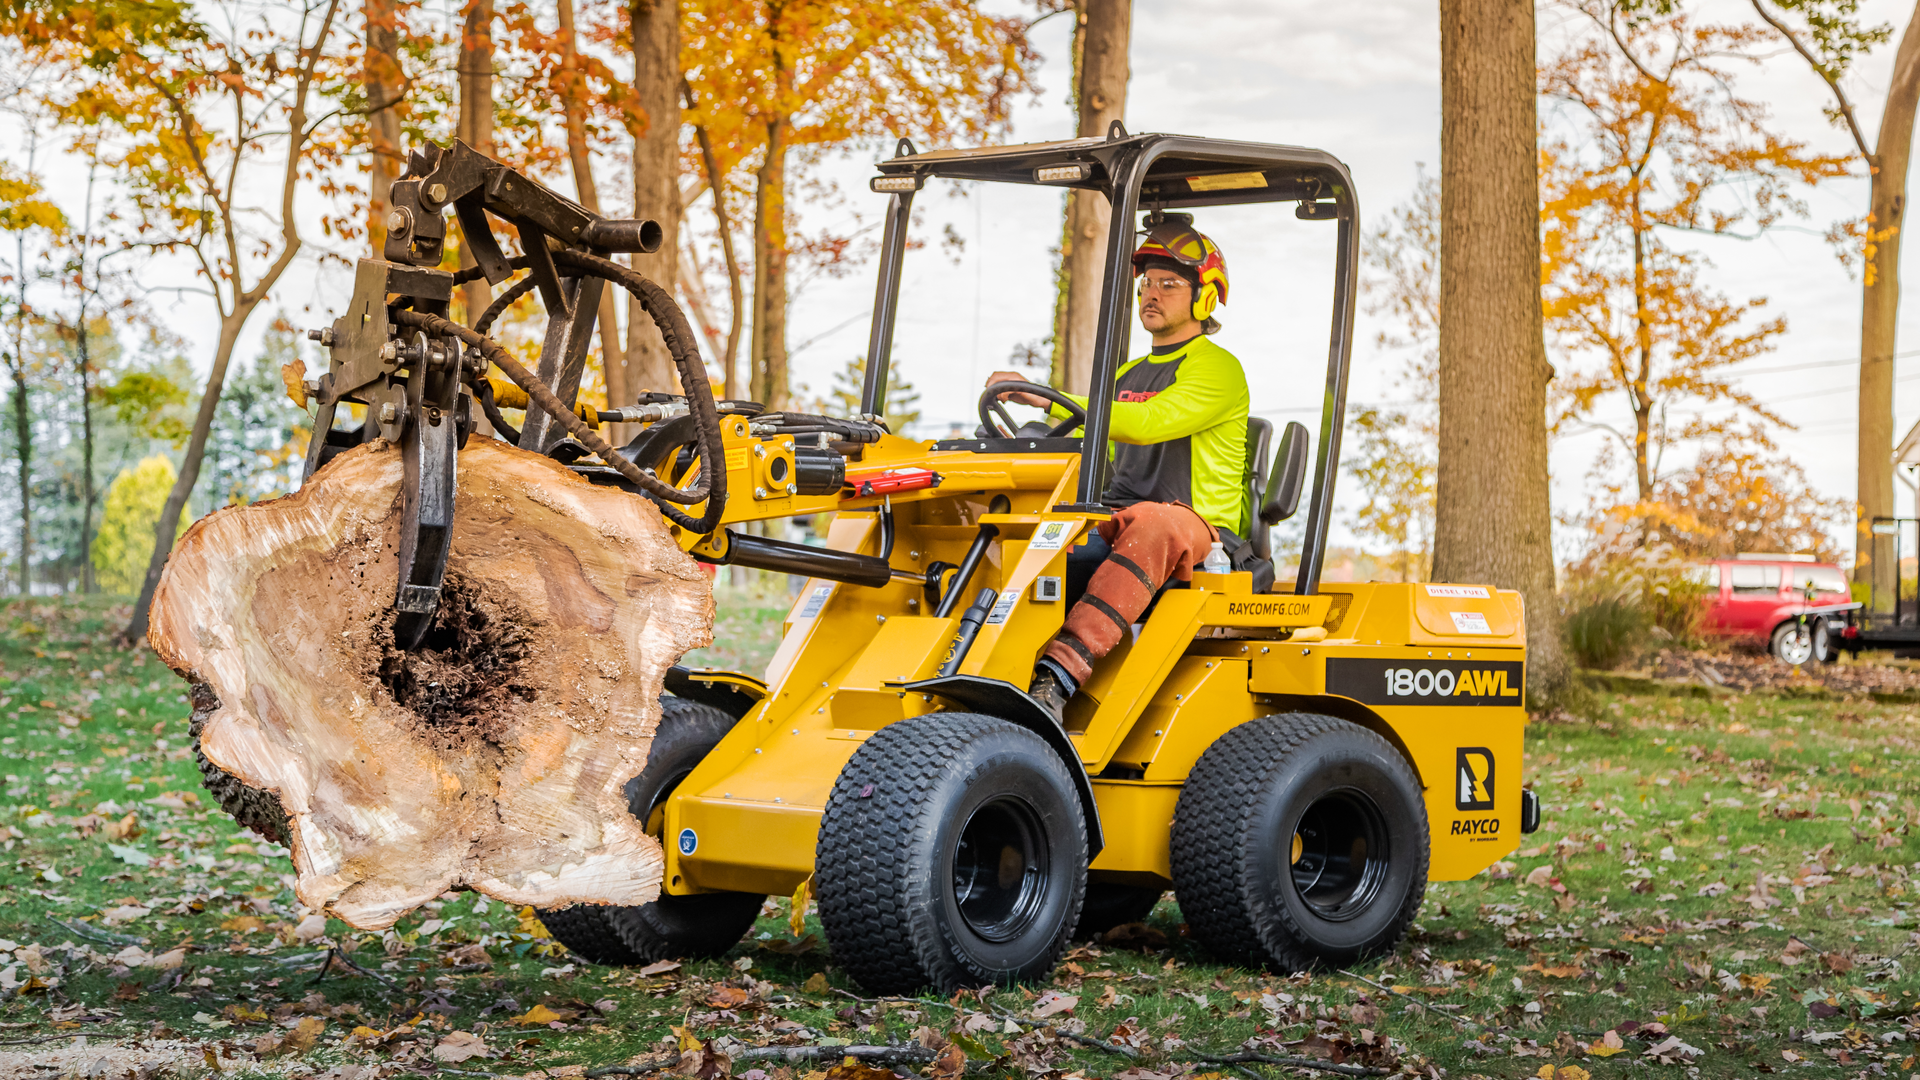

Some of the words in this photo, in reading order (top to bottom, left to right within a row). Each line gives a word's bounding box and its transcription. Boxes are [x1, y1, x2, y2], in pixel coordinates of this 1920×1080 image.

[1045, 523, 1064, 535] 811
[1228, 602, 1310, 616] RAYCOMFG.COM
[1384, 668, 1519, 697] 1800AWL
[1450, 818, 1500, 836] RAYCO
